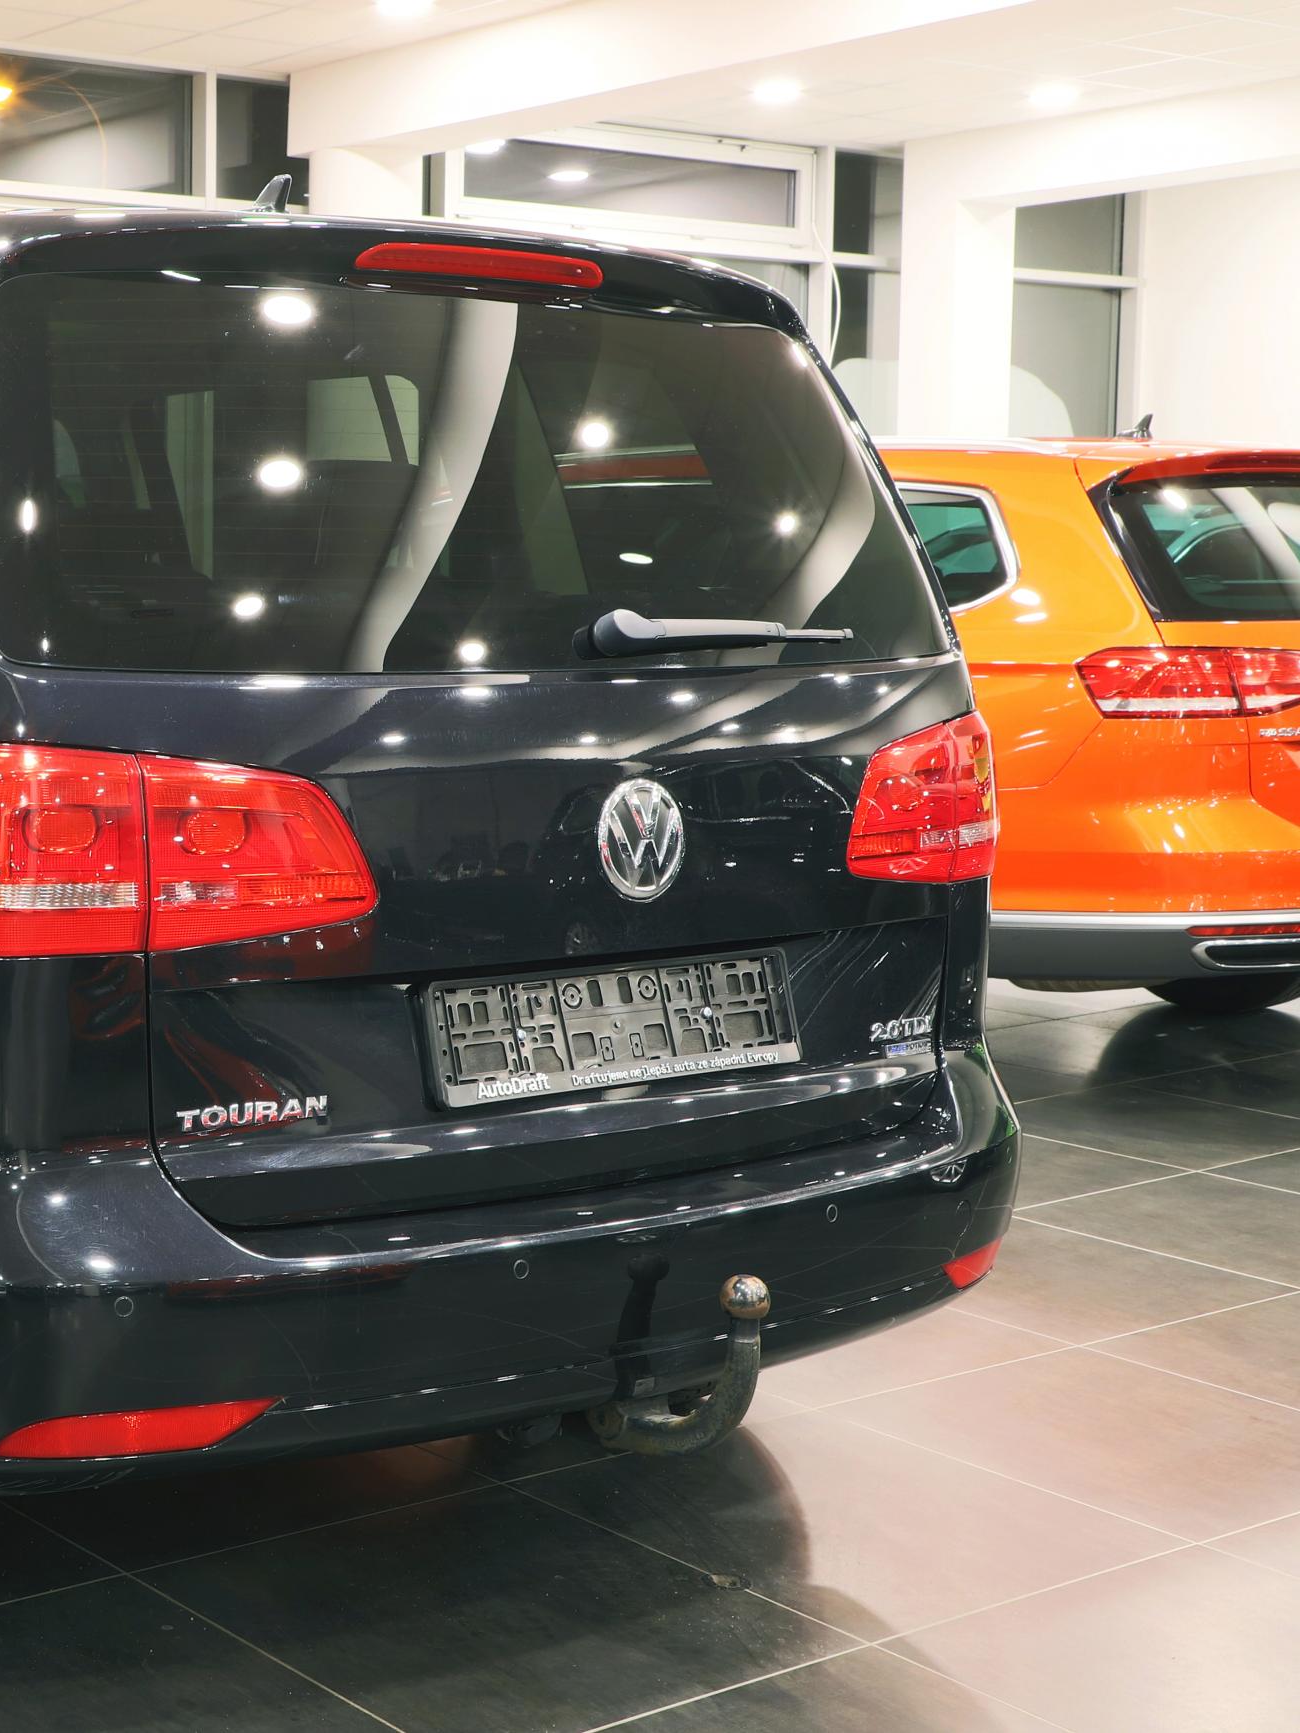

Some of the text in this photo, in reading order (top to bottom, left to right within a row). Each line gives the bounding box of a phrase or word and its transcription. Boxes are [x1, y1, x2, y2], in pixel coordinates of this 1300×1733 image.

[477, 1073, 550, 1099] AutoDraft
[572, 1051, 779, 1086] Draftujeme nejlepší auta ze západní Evropy
[176, 1095, 328, 1132] TOURAN
